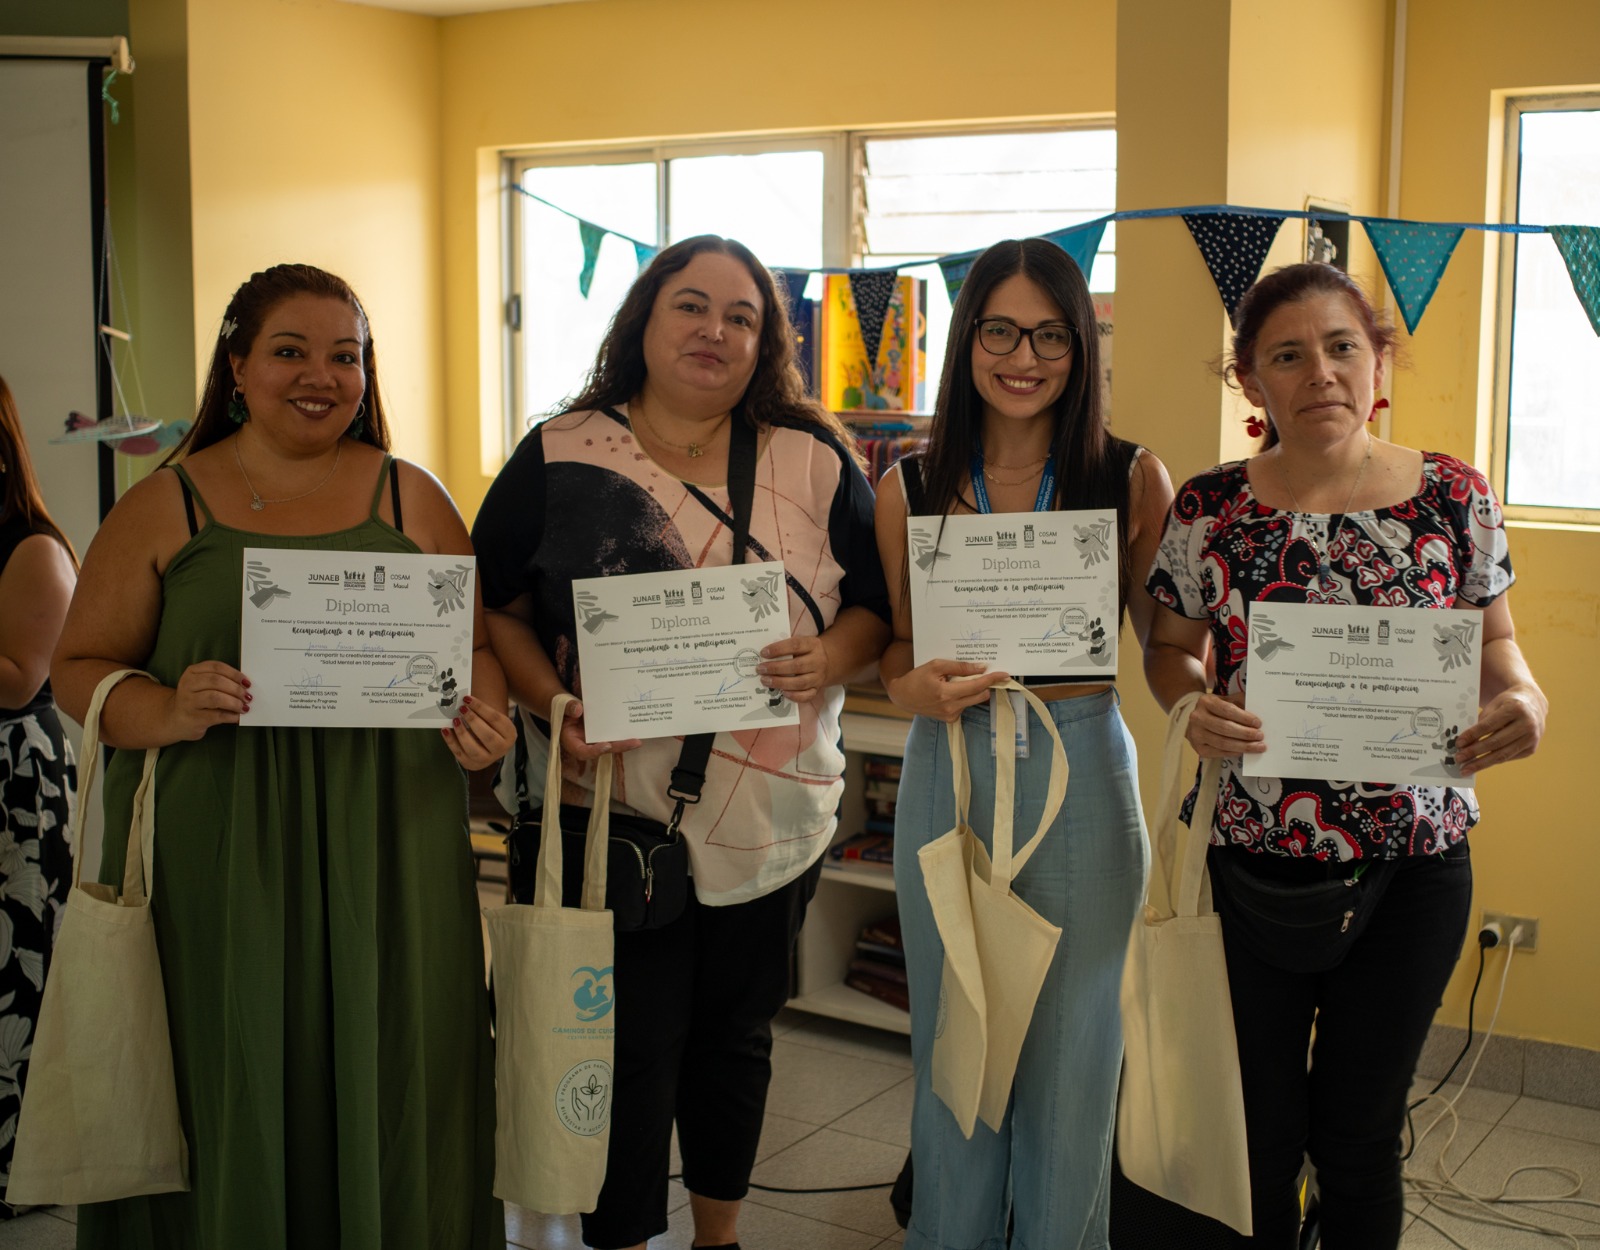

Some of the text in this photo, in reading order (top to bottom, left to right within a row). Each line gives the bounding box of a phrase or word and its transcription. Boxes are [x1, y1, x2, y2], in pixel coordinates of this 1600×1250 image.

[965, 535, 993, 543] JUNAEB
[982, 557, 1041, 573] Diploma
[308, 574, 340, 582] JUNAEB
[954, 585, 999, 593] Reconocimiento
[1012, 584, 1018, 592] la
[1023, 583, 1065, 593] participación
[632, 594, 661, 603] JUNAEB
[326, 599, 390, 616] Diploma
[651, 613, 711, 633] Diploma
[1312, 627, 1343, 635] JUNAEB
[292, 627, 343, 636] Reconocimiento
[369, 629, 415, 639] participación
[624, 643, 670, 655] Reconocimiento
[694, 637, 737, 650] participación
[1329, 652, 1394, 671] Diploma
[1295, 679, 1346, 690] Reconocimiento
[1360, 682, 1368, 690] la
[1372, 683, 1419, 695] participación
[552, 1027, 585, 1035] CAMINOS
[560, 1068, 582, 1096] PROGRAMA
[560, 1106, 581, 1131] BIENESTAR
